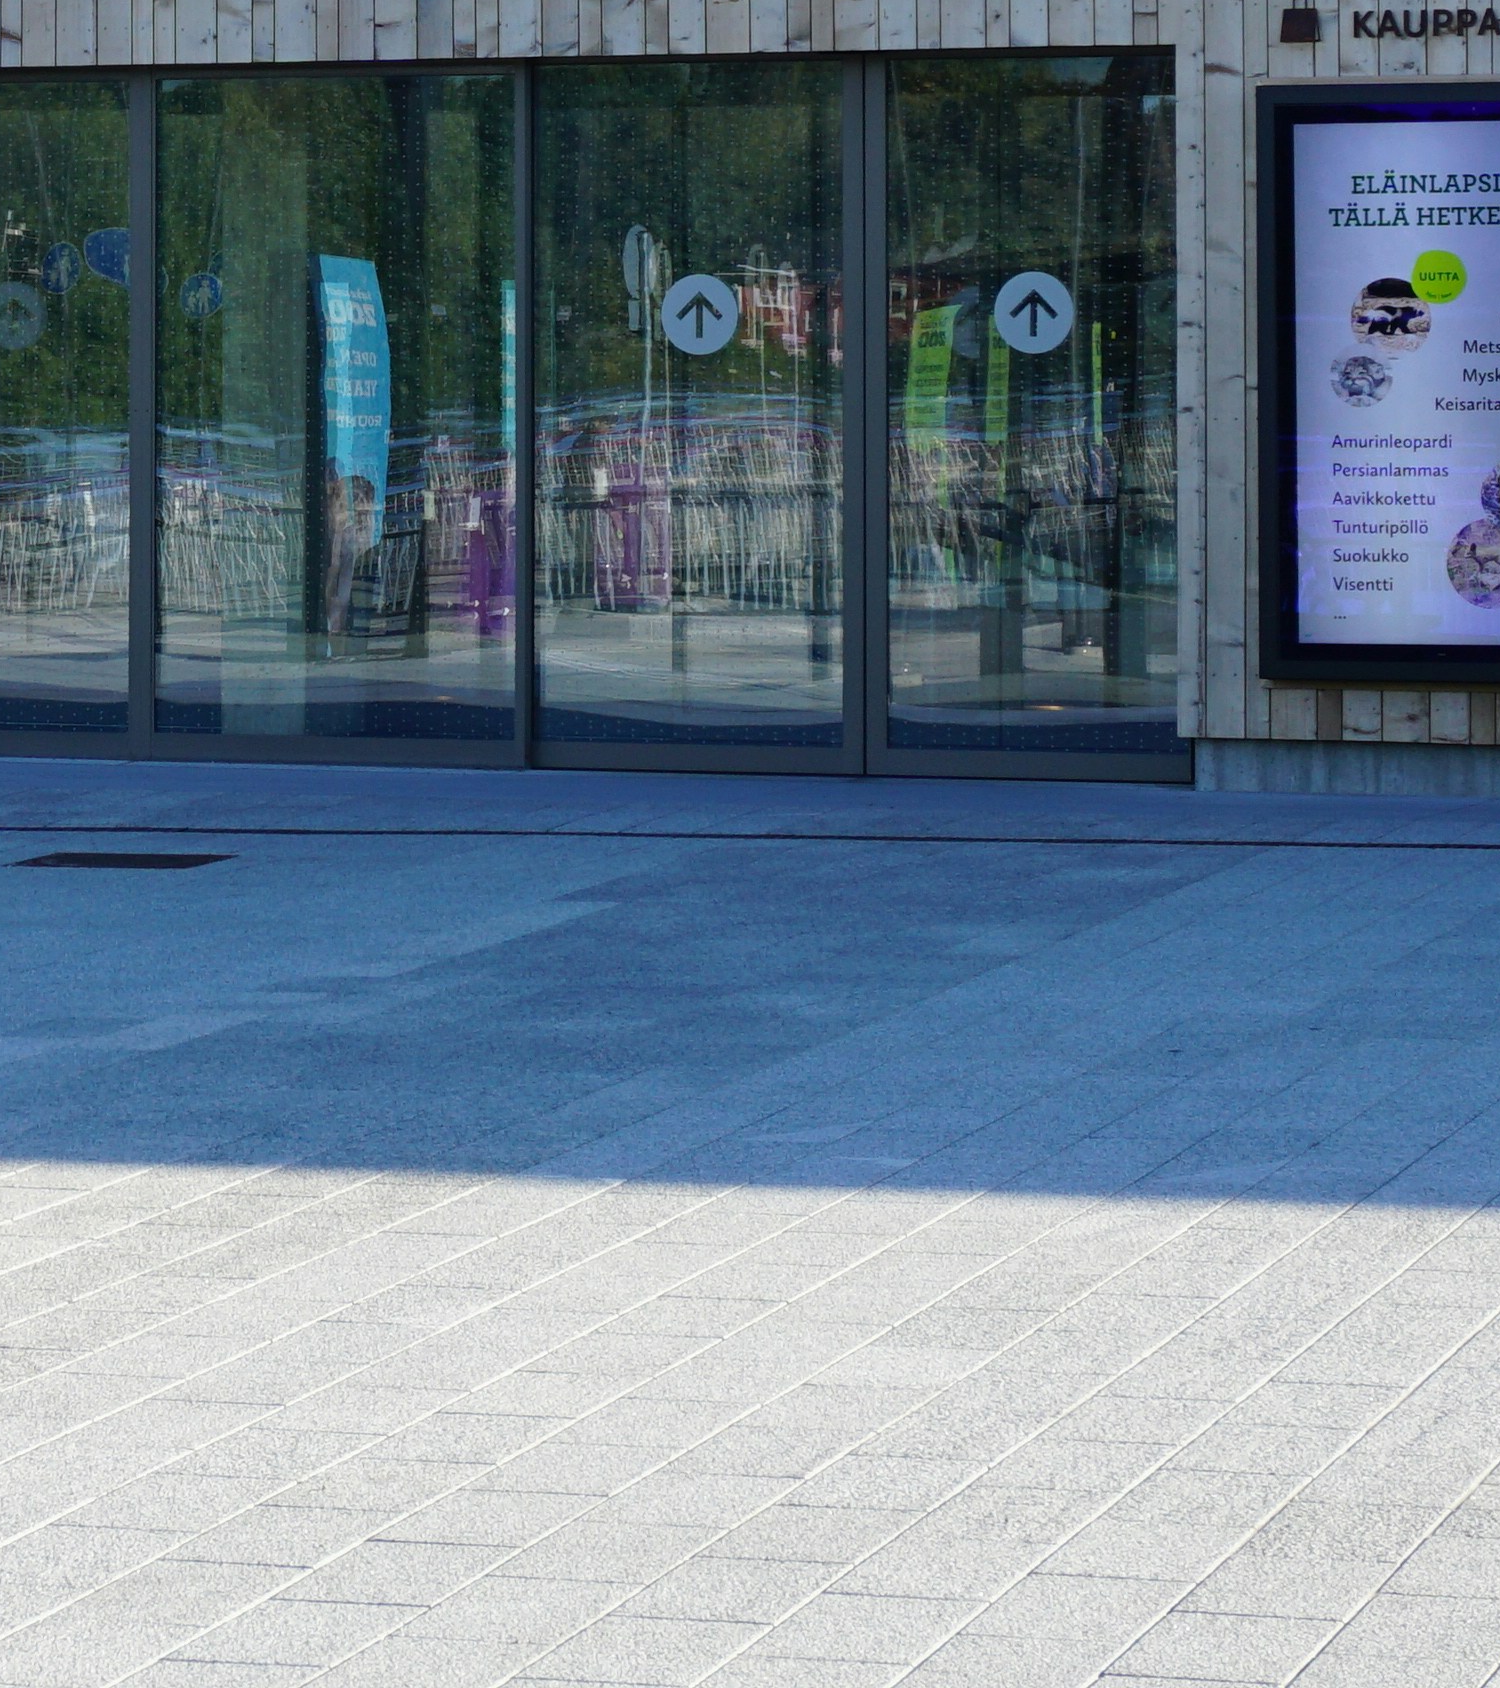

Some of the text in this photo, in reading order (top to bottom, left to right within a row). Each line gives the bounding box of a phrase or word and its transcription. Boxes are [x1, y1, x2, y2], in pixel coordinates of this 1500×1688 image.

[1329, 203, 1409, 226] TÄLLÄ
[1419, 272, 1459, 281] UUTTA
[1332, 434, 1452, 451] Amurinleopardi
[1333, 463, 1448, 477] Persianlammas
[1333, 491, 1435, 505] Aavikkokettu
[1332, 520, 1428, 537] Tunturipöllö
[1333, 548, 1409, 562] Suokukko
[1333, 577, 1393, 591] Visentti
